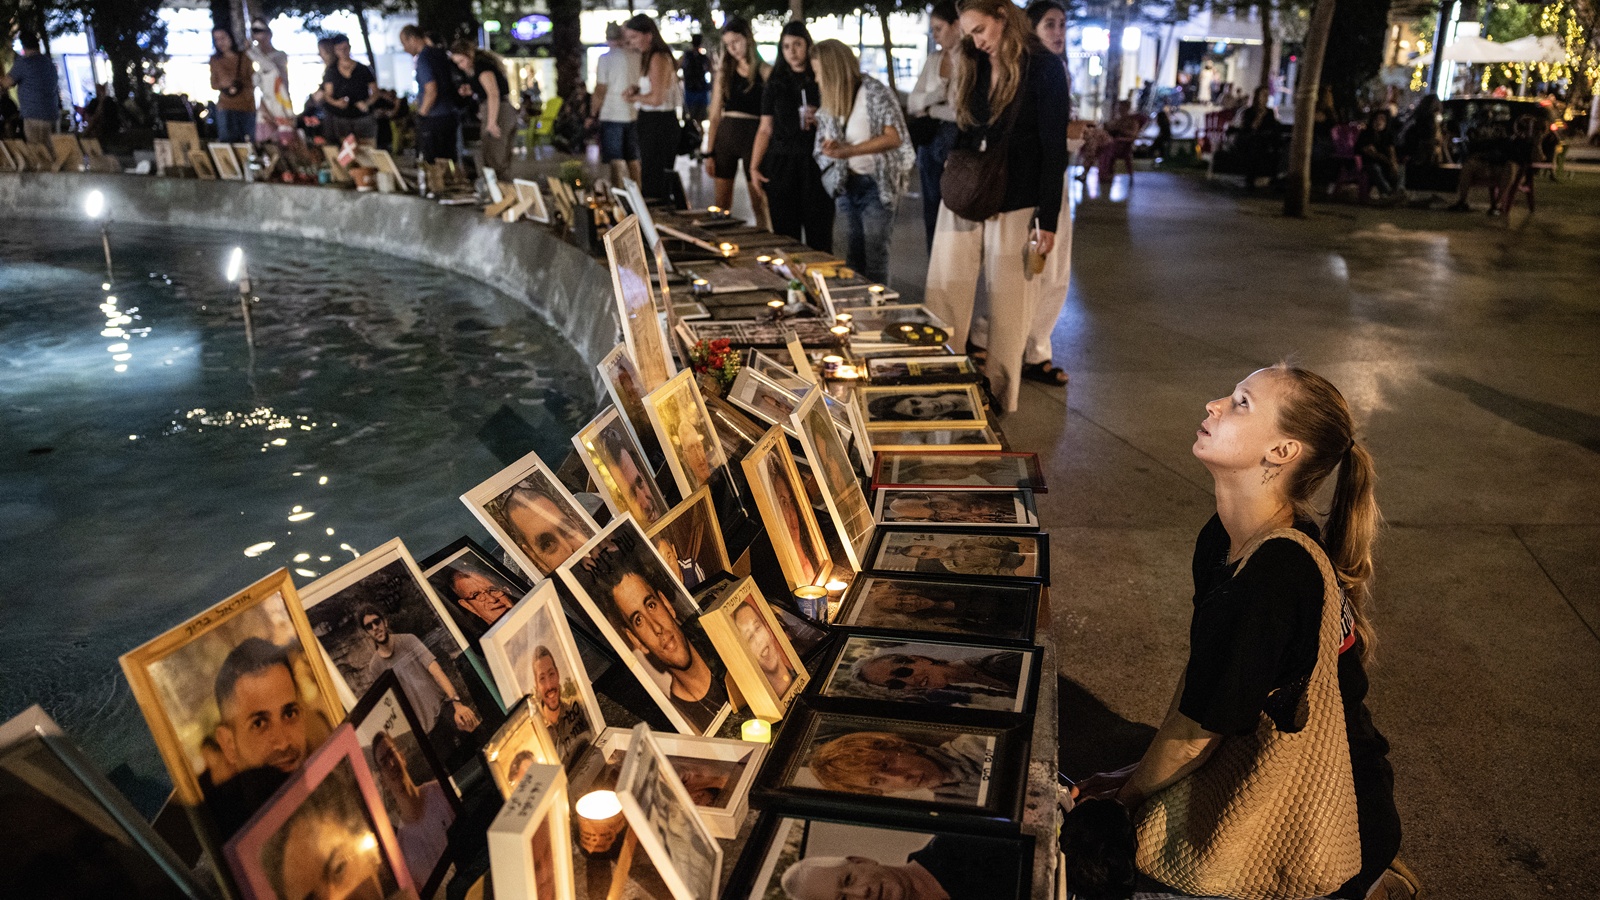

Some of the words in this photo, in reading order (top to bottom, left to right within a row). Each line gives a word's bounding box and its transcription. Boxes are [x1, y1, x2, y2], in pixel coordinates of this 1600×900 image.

[580, 547, 614, 584] דניאל
[216, 593, 251, 616] אוריאל
[185, 616, 212, 636] ברוך
